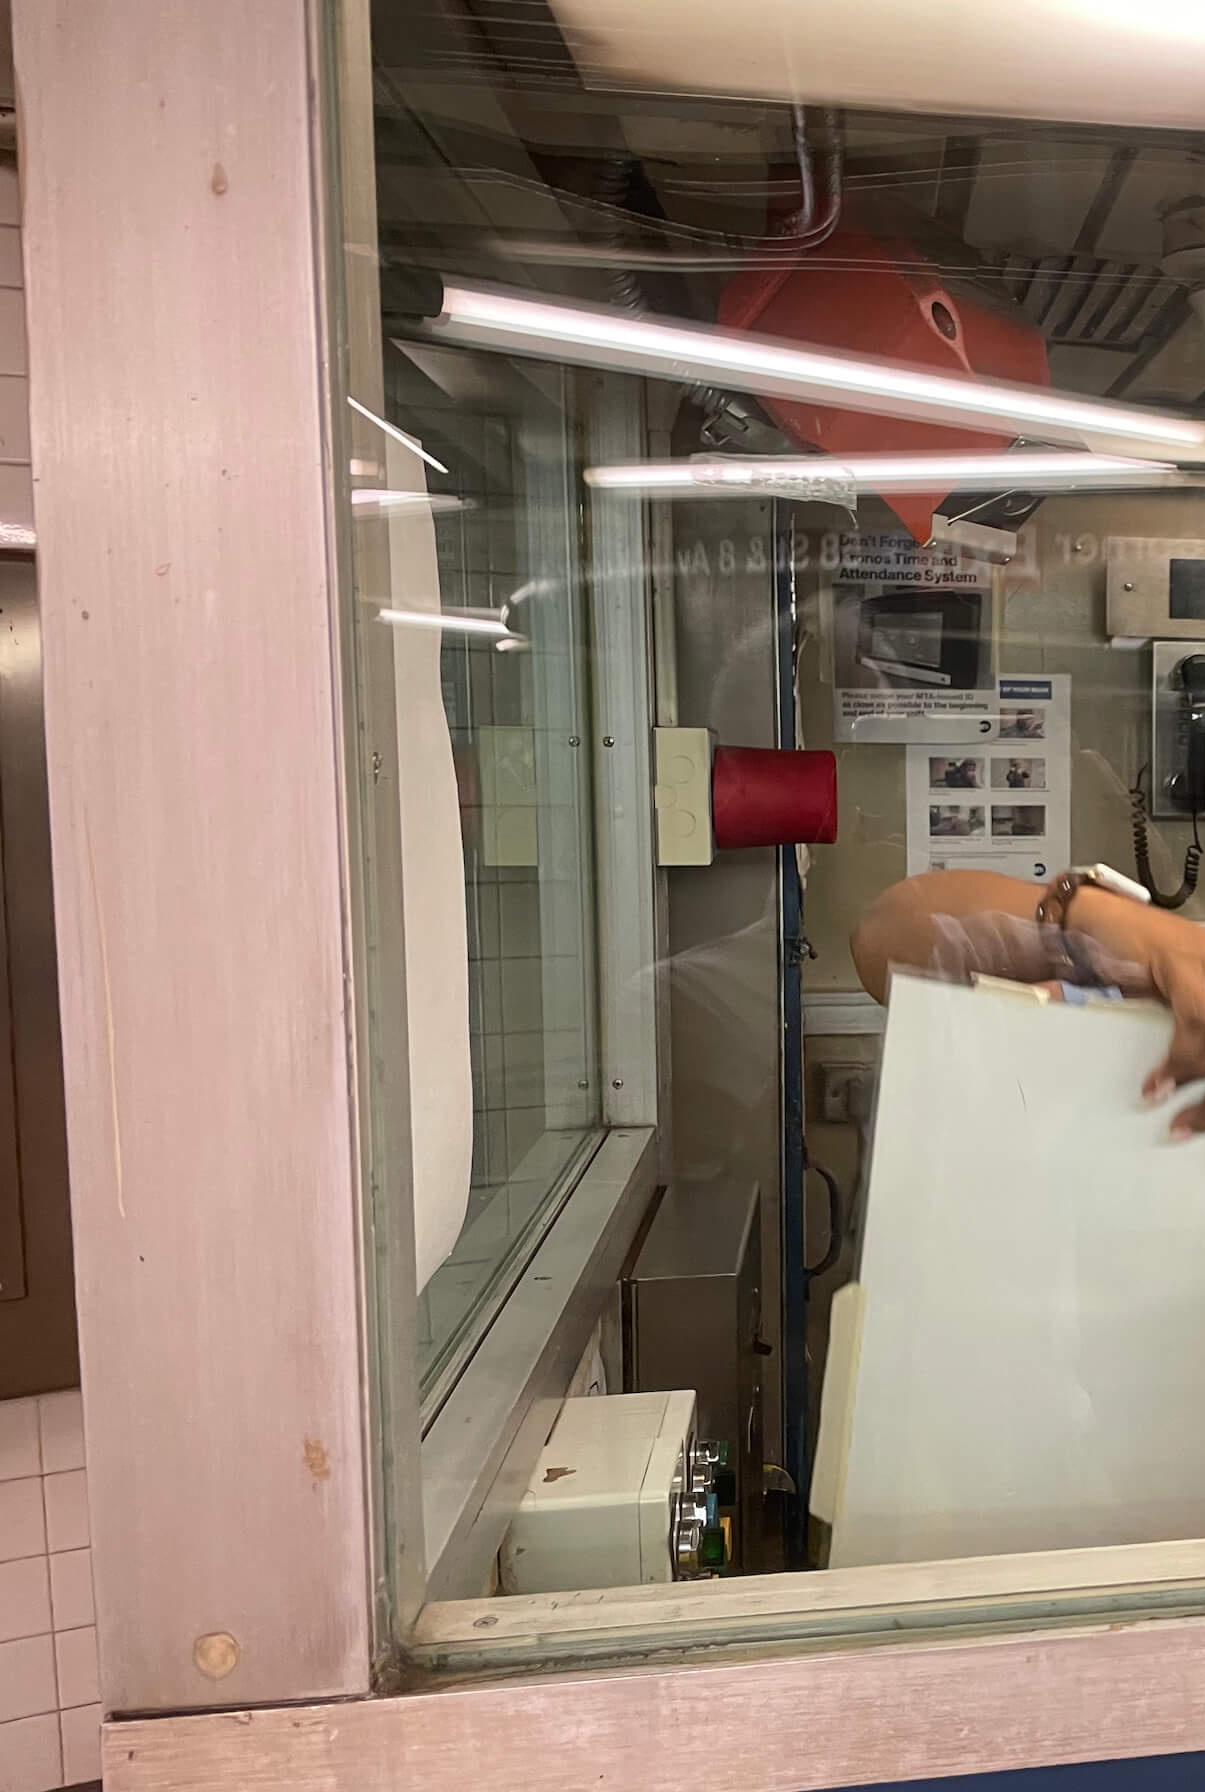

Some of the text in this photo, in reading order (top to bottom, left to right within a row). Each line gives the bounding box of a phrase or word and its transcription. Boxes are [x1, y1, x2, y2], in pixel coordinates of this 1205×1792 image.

[894, 551, 929, 566] Time
[931, 555, 957, 567] and
[839, 567, 977, 584] Attendance System
